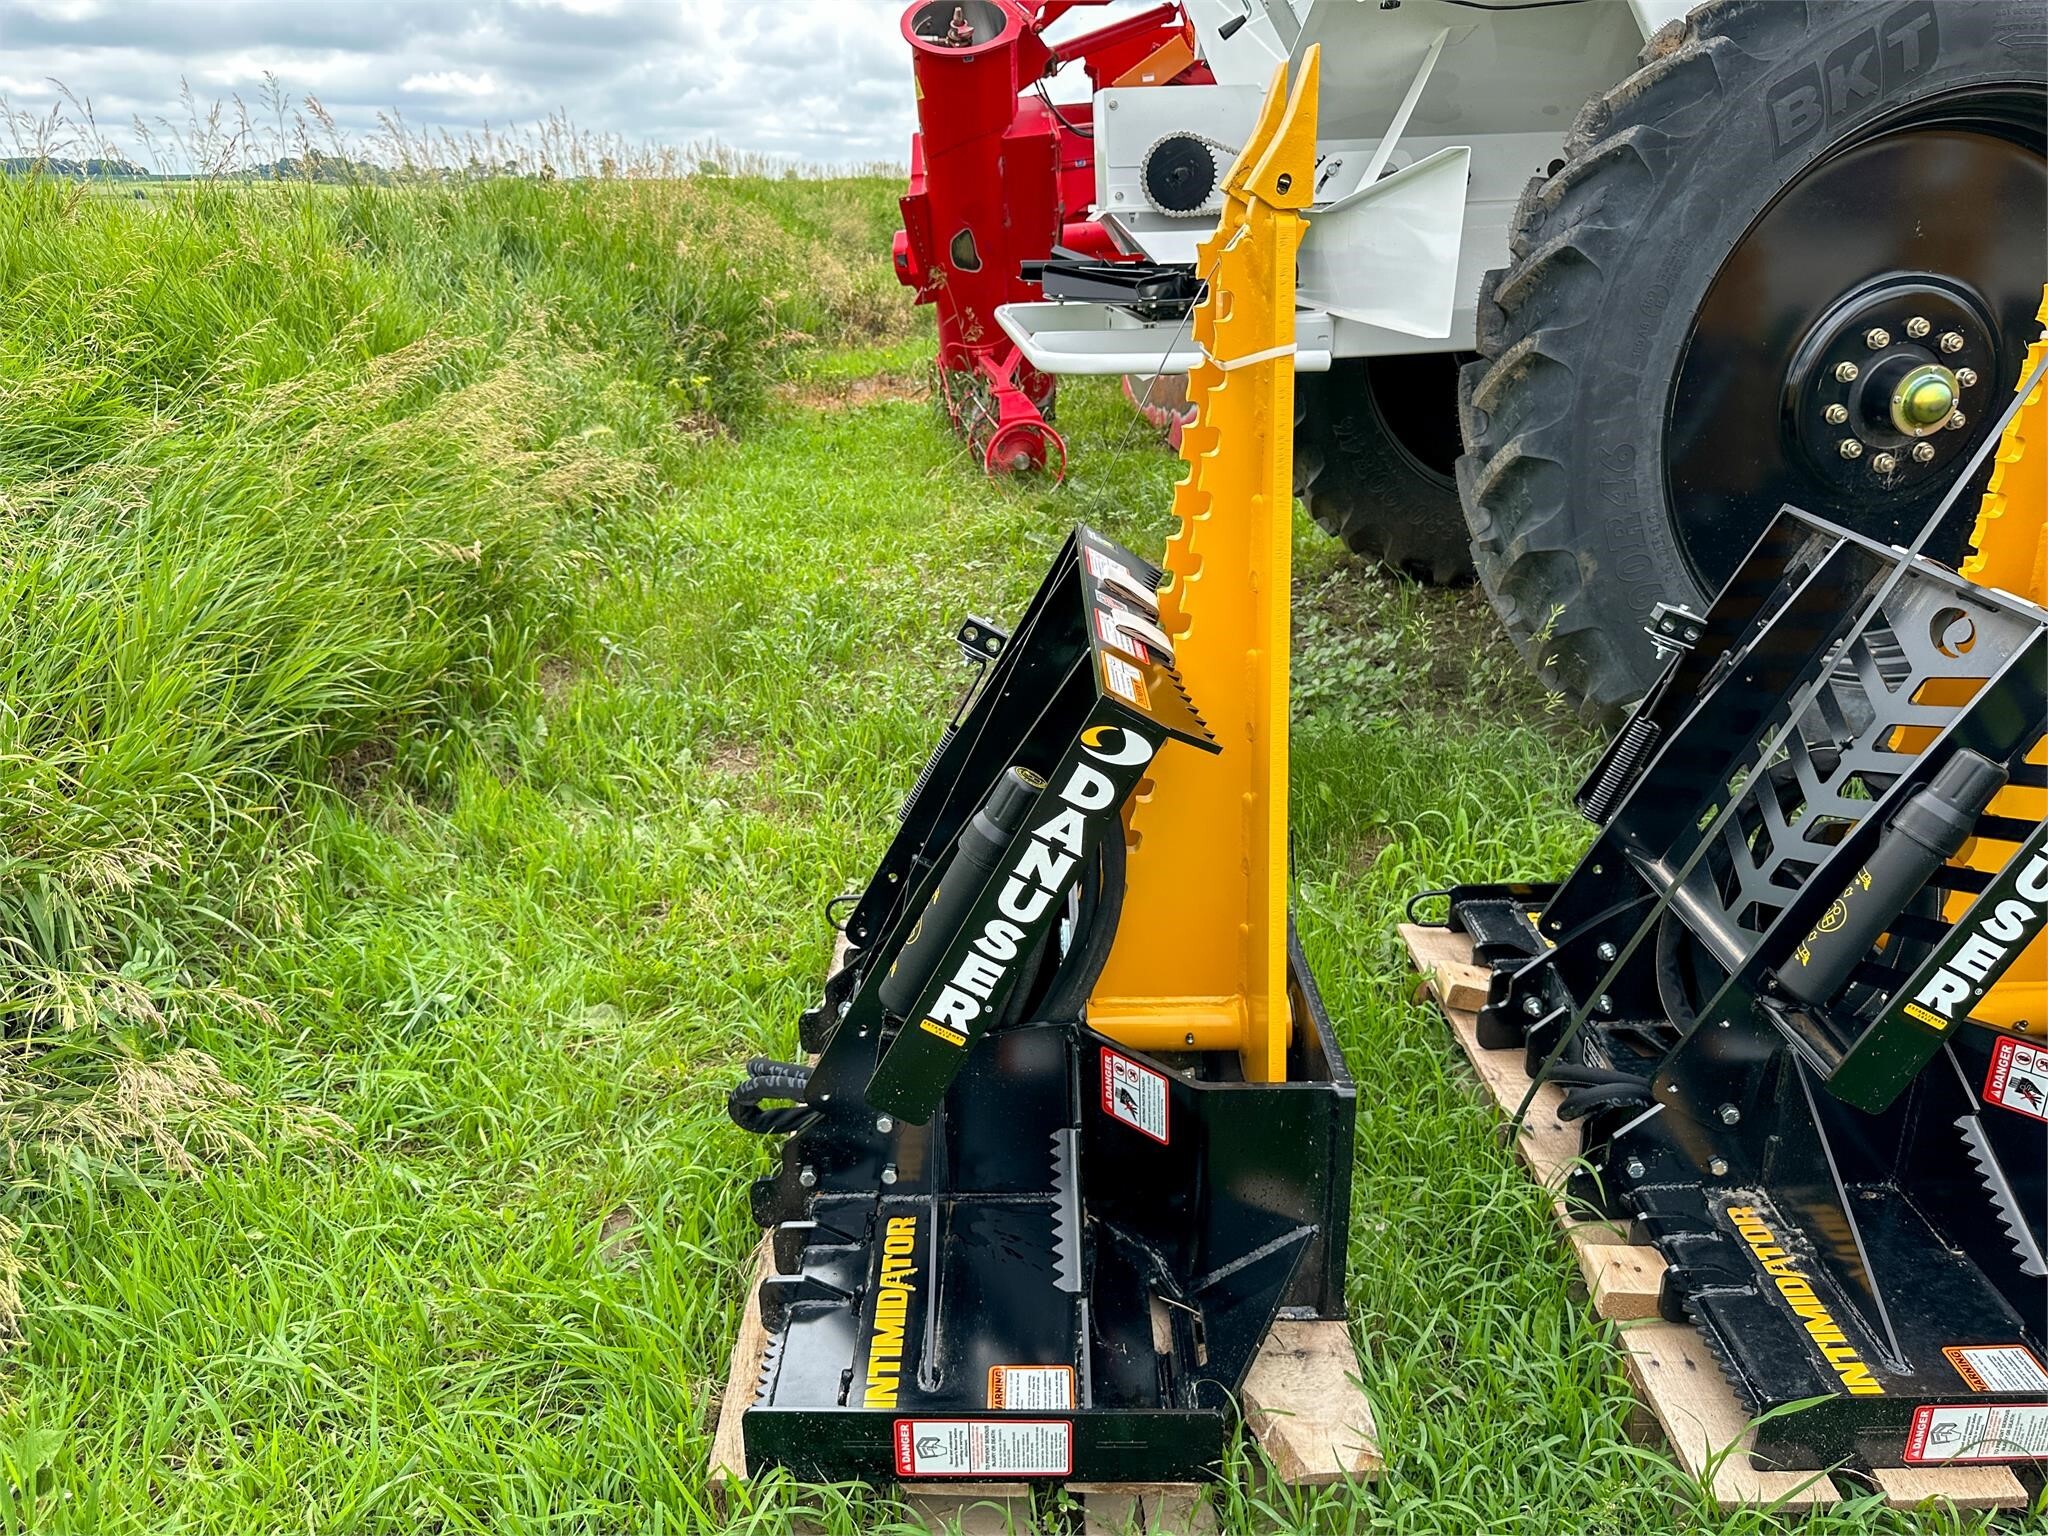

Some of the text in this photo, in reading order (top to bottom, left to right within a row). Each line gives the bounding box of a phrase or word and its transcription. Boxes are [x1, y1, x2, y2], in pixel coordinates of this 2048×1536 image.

[1772, 12, 1932, 146] BKT
[927, 762, 1115, 1034] DANUSER
[1914, 842, 2048, 1019] USER
[1104, 1055, 1113, 1097] DANGER
[1993, 1045, 2012, 1089] DANGER
[863, 1216, 918, 1408] INTIMIDATOR
[1727, 1206, 1885, 1394] INTIMIDATOR
[902, 1424, 910, 1462] DANGER
[1915, 1410, 1929, 1452] DANGER
